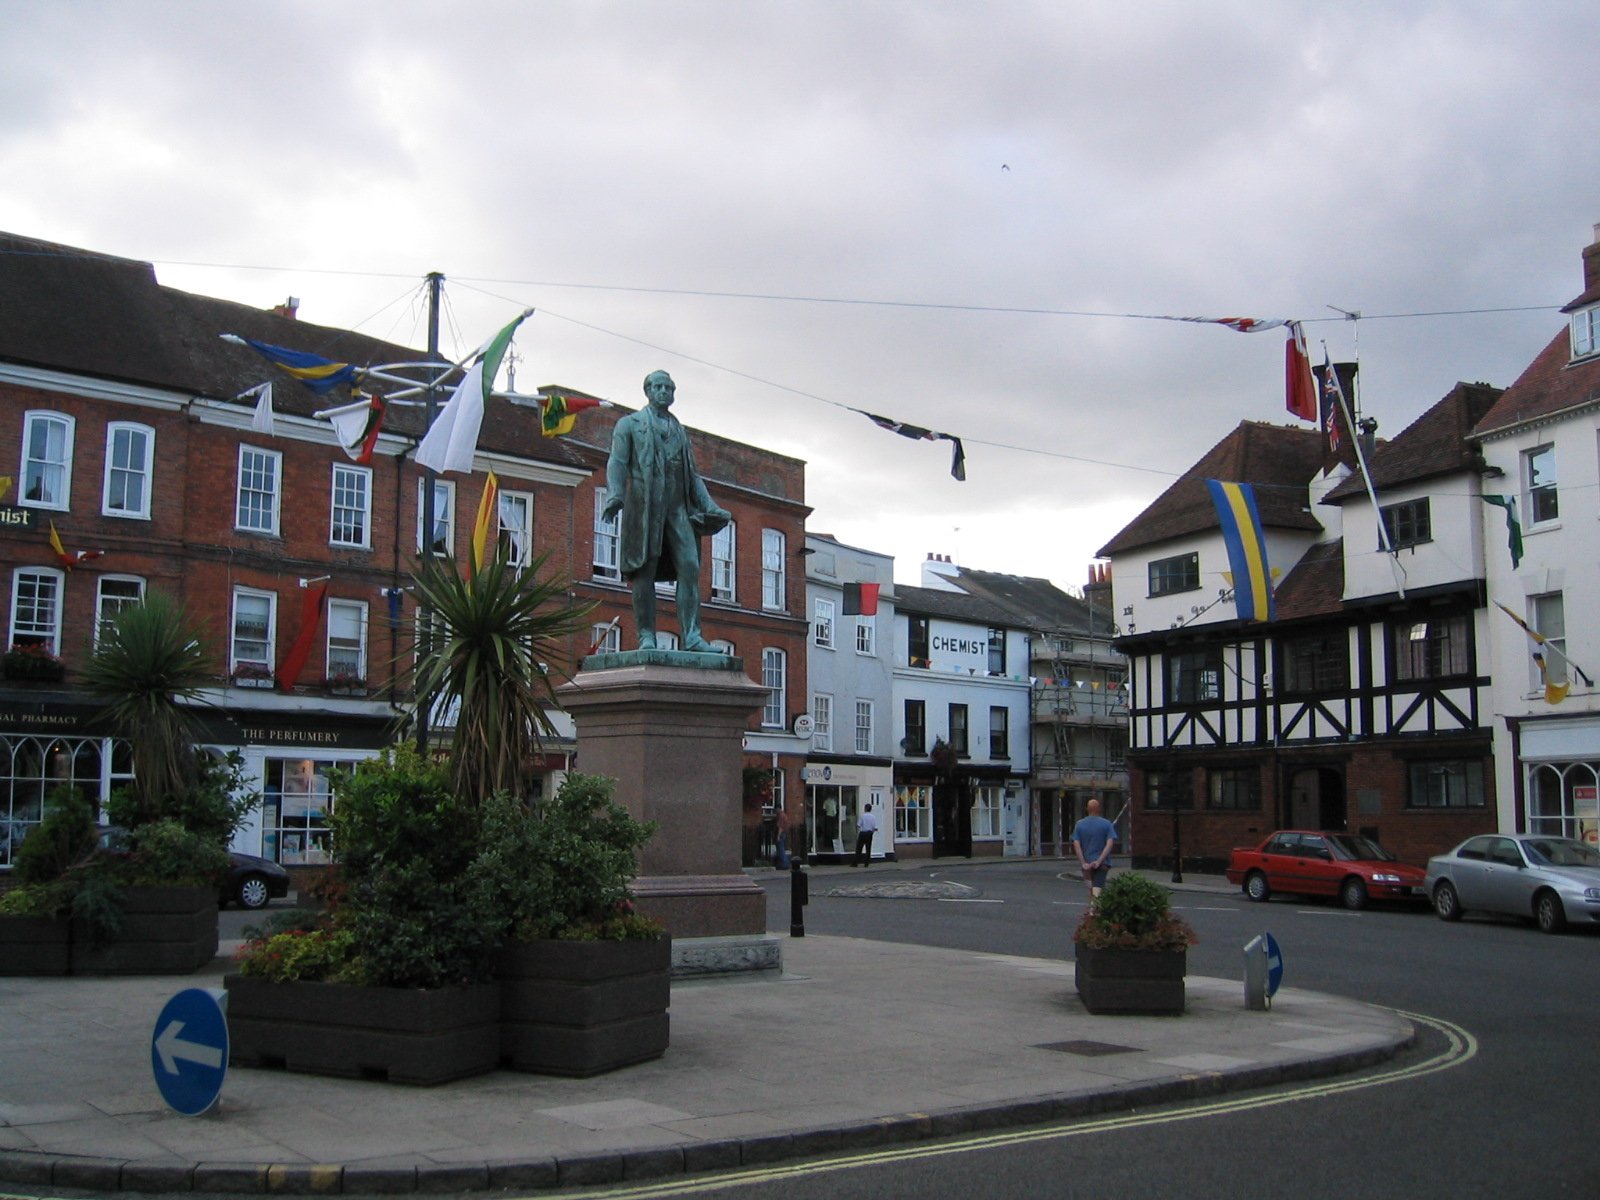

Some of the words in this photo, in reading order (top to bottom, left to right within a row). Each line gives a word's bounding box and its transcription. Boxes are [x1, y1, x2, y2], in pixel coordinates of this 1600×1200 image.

[932, 636, 986, 655] CHEMIST
[22, 714, 78, 724] PHARMACY
[241, 728, 266, 739] THE
[269, 729, 340, 743] PERFUMERY
